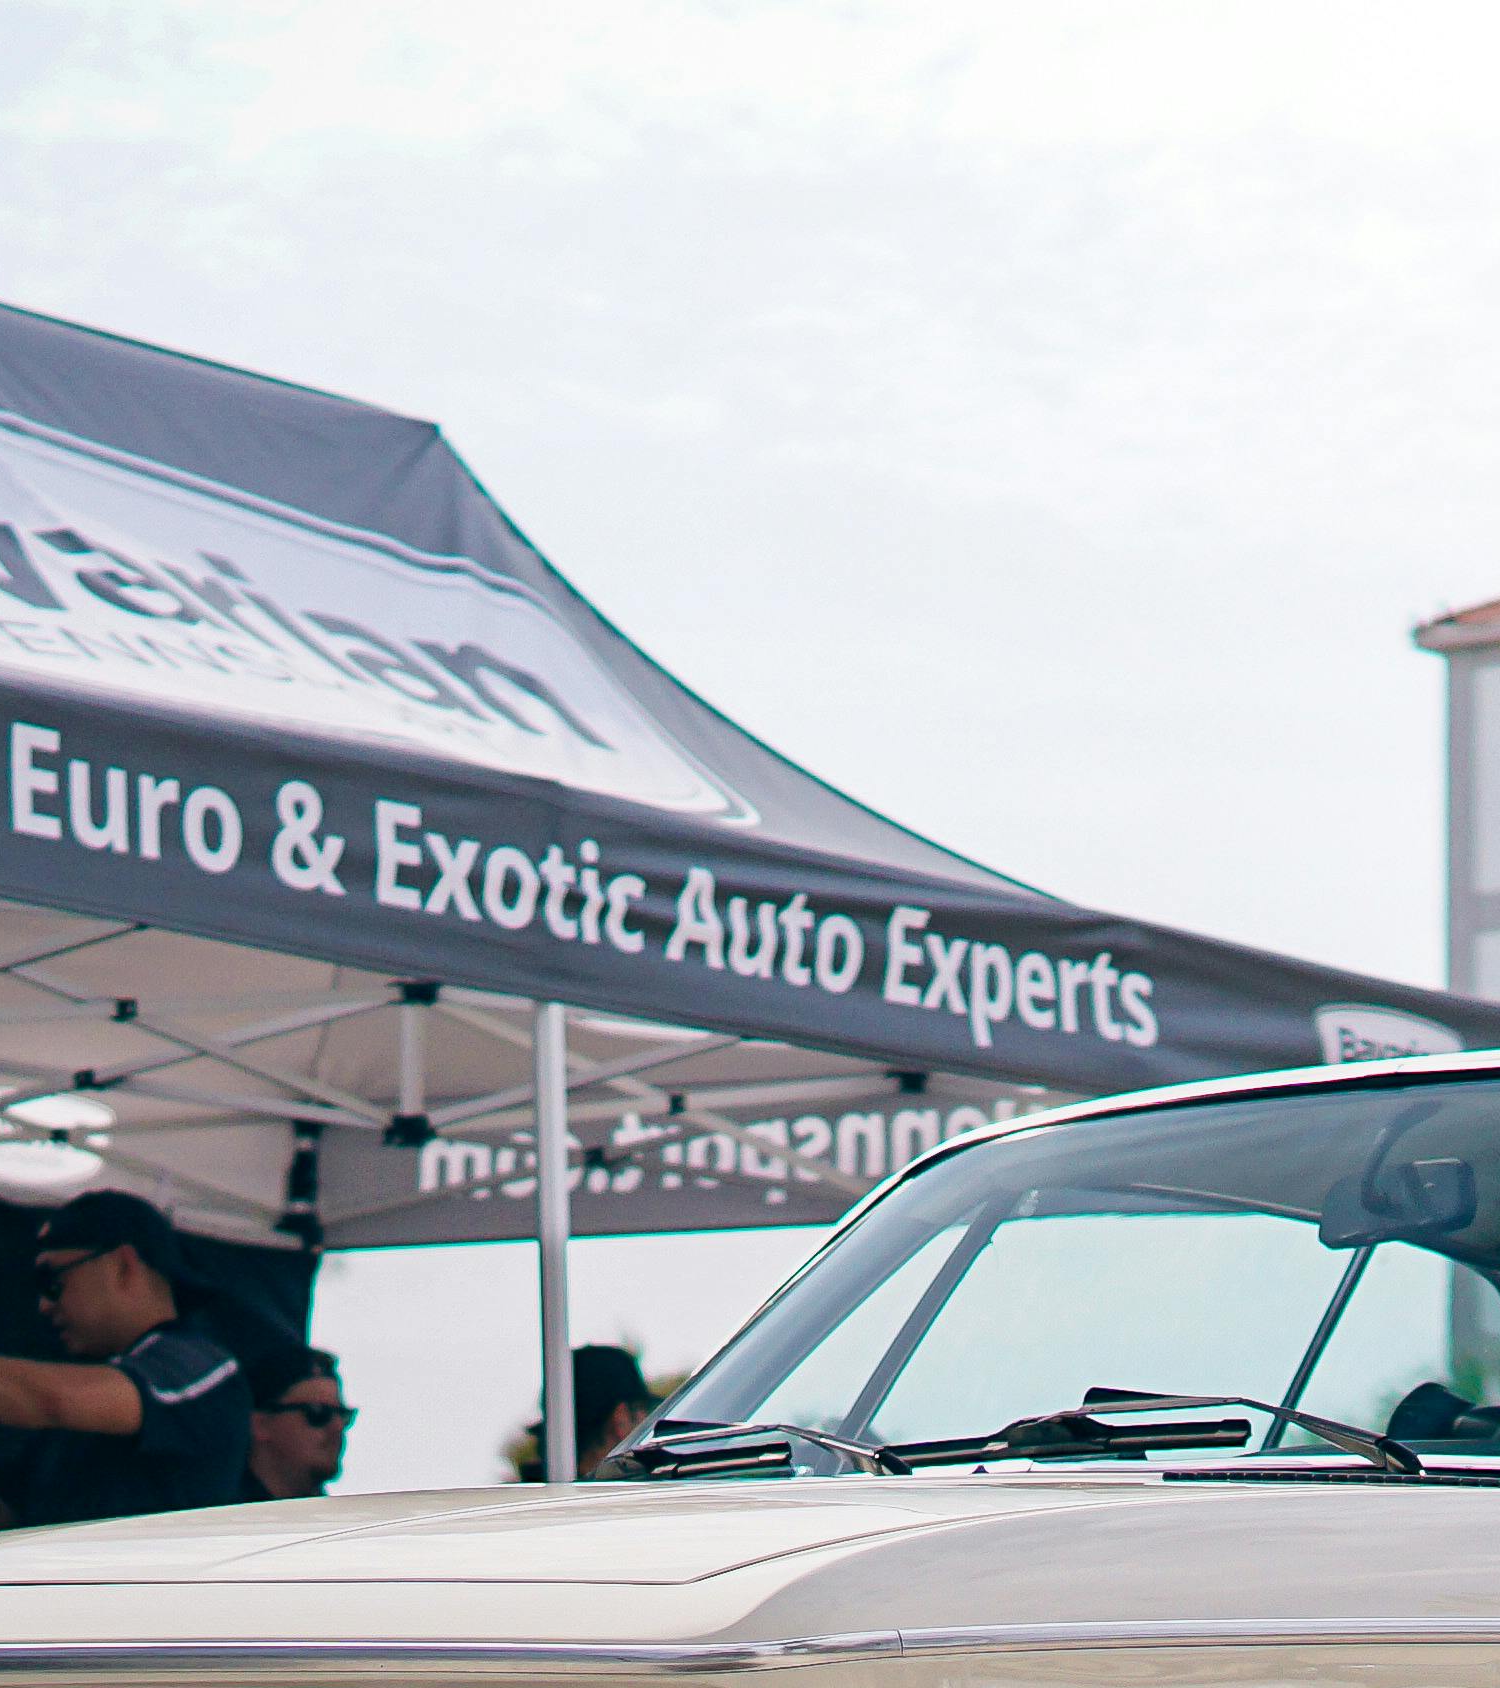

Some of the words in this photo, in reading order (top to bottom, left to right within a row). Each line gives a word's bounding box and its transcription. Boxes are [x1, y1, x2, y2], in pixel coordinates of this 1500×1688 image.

[10, 721, 243, 874] Euro
[271, 779, 347, 896] &
[374, 799, 647, 954] Exotic
[665, 865, 866, 995] Auto
[882, 905, 1161, 1048] Experts
